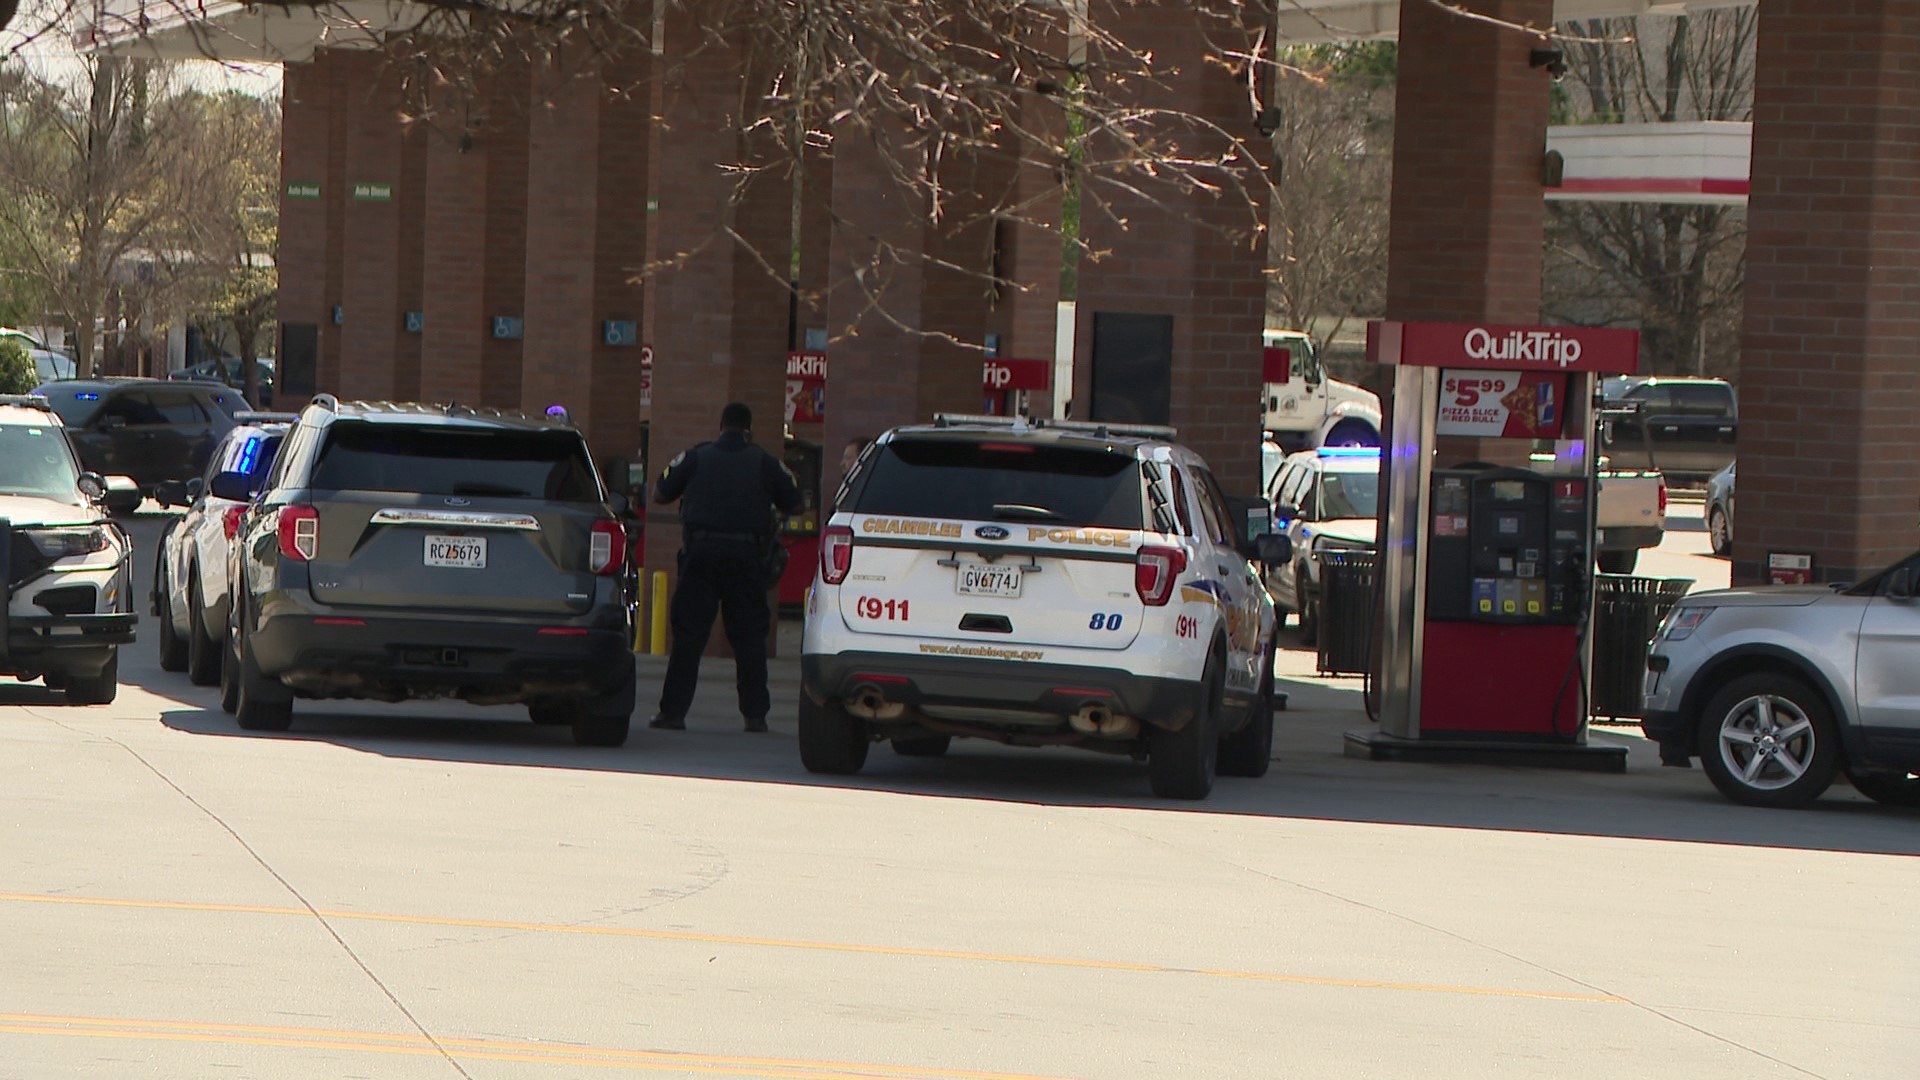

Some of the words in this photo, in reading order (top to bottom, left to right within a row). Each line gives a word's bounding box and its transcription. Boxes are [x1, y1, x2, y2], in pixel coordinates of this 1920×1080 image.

[1464, 328, 1582, 367] QuikTrip
[1442, 407, 1470, 415] PIZZA
[1472, 408, 1500, 416] SLICE
[1451, 415, 1471, 423] RED
[1565, 482, 1572, 496] 1
[862, 517, 963, 538] CHAMBLEE
[979, 527, 1004, 538] Ford
[1027, 527, 1131, 548] POLICE
[966, 571, 1019, 590] GV6774J
[866, 597, 909, 621] 911
[1089, 612, 1123, 631] 80
[1180, 616, 1197, 640] 911
